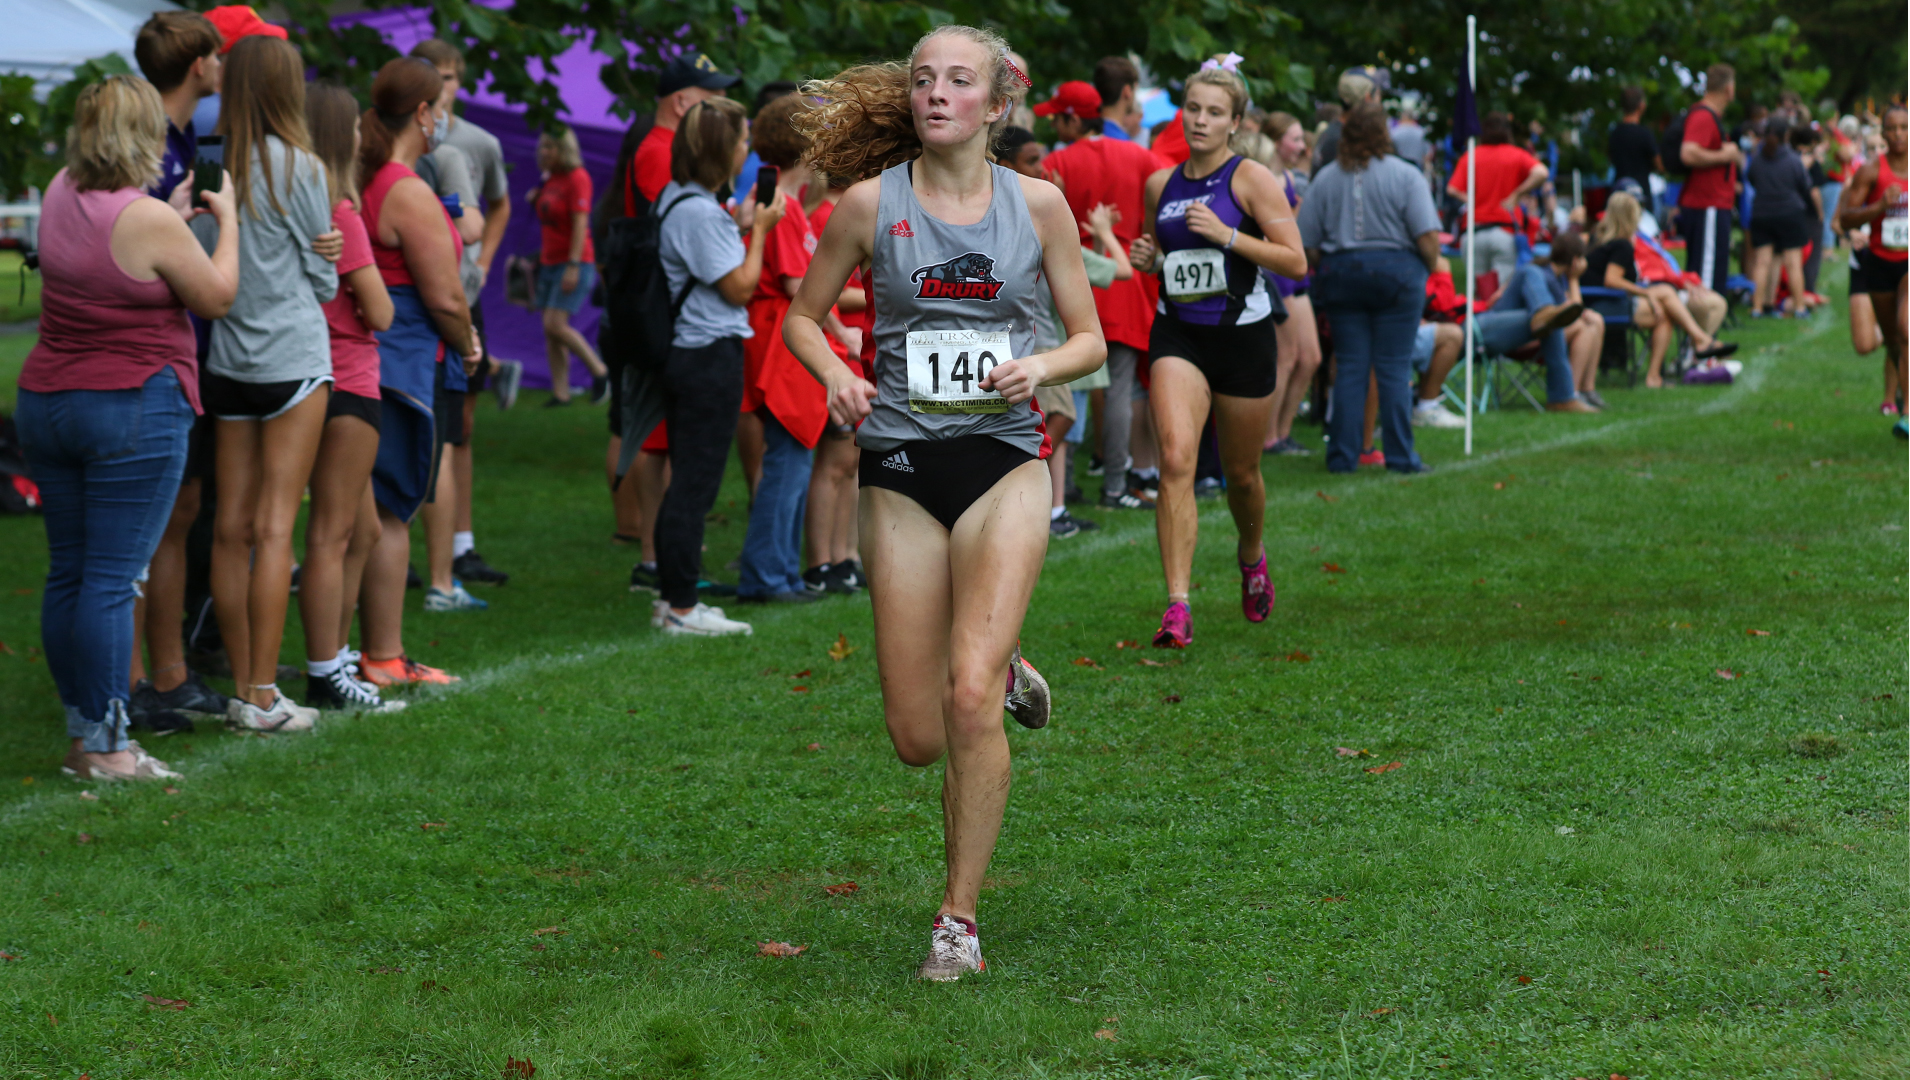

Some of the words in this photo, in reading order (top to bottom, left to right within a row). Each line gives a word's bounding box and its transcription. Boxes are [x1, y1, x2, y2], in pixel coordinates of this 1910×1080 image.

[889, 228, 915, 238] adidas
[1174, 262, 1213, 289] 497
[921, 279, 1001, 299] DRURY
[936, 332, 981, 340] TRXC
[928, 350, 999, 394] 140
[881, 460, 915, 473] adidas
